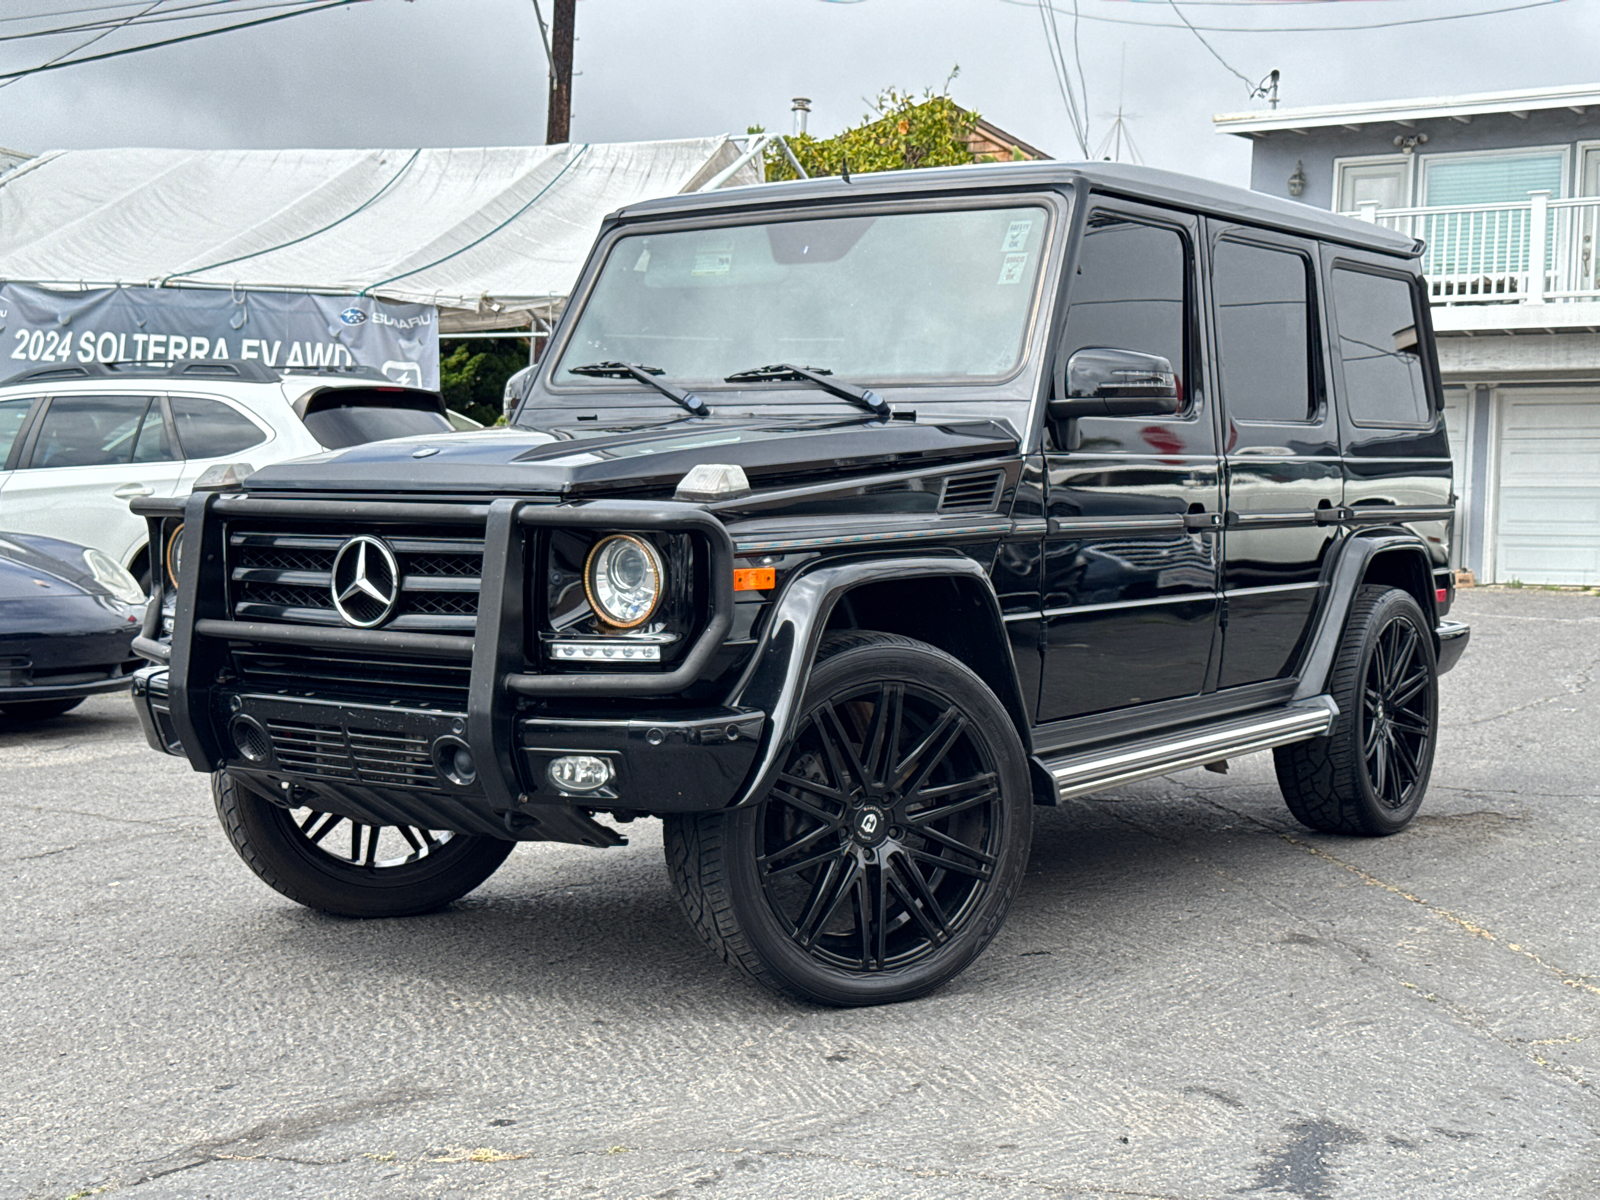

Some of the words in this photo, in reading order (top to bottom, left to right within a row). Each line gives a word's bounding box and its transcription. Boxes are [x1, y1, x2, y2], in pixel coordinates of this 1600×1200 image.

[1009, 240, 1019, 248] OK
[11, 328, 73, 362] 2024
[77, 331, 229, 367] SOLTERRA
[241, 339, 281, 367] EV
[284, 341, 353, 374] AWD
